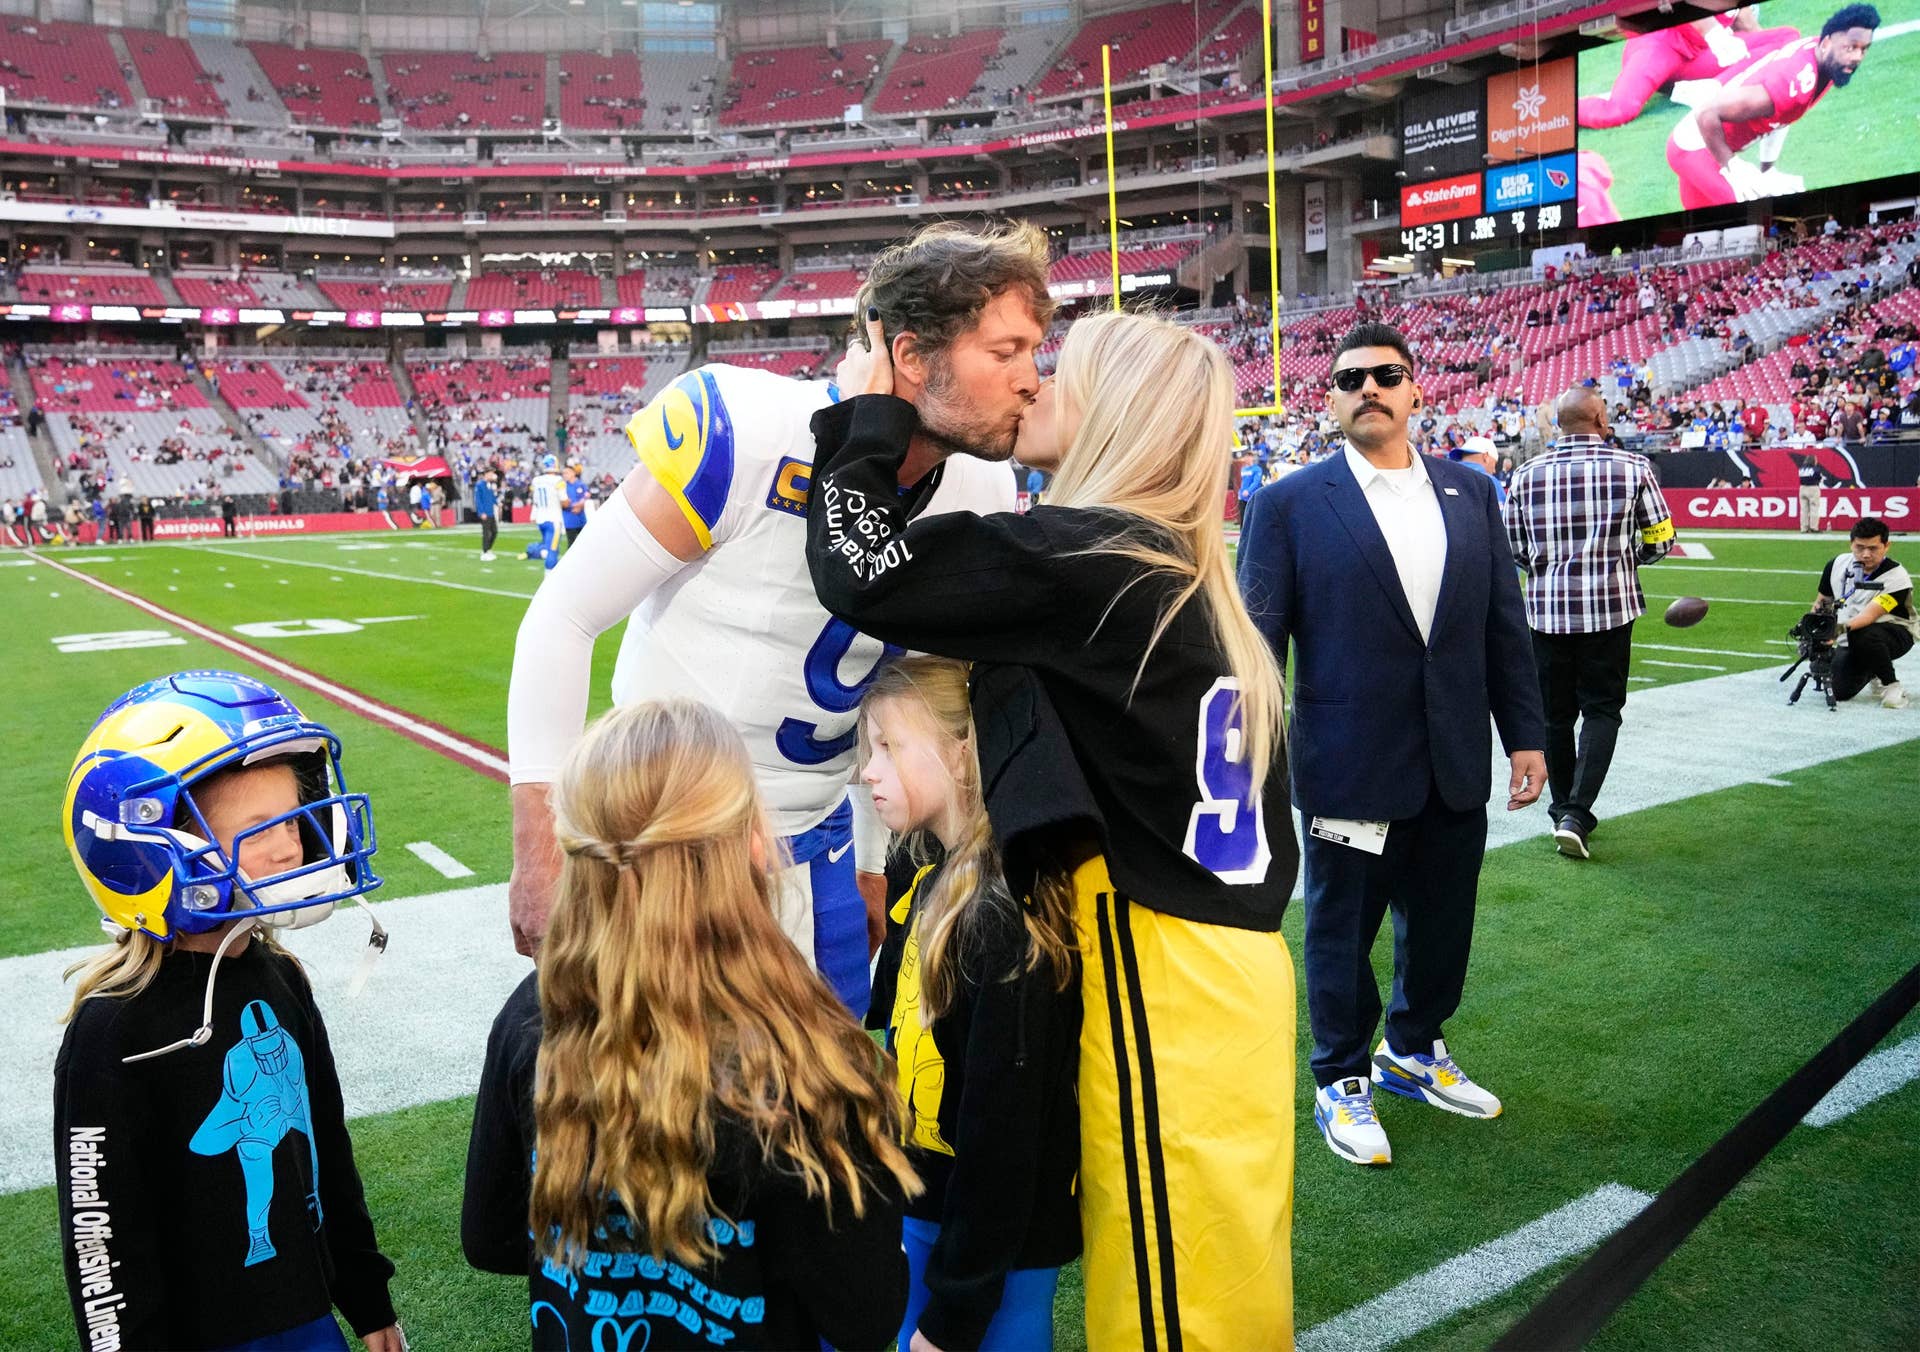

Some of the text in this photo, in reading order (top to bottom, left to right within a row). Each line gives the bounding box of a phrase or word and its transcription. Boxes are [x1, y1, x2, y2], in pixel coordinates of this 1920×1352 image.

[1021, 131, 1073, 147] MARSHALL
[1074, 122, 1128, 138] GOLDBRG
[1404, 111, 1477, 138] GILA RIVER
[1491, 115, 1570, 144] Dignity Health
[250, 159, 279, 170] LANE
[574, 166, 601, 176] KURT
[603, 166, 648, 176] WARNER
[763, 160, 790, 169] HART
[1496, 182, 1535, 201] LIGHT
[1501, 173, 1529, 189] BUD
[154, 519, 305, 534] ARIZONA ARDINALS
[1183, 676, 1272, 885] 9
[70, 1127, 109, 1208] National
[72, 1211, 121, 1298] Offensive
[584, 1289, 736, 1346] DADDY
